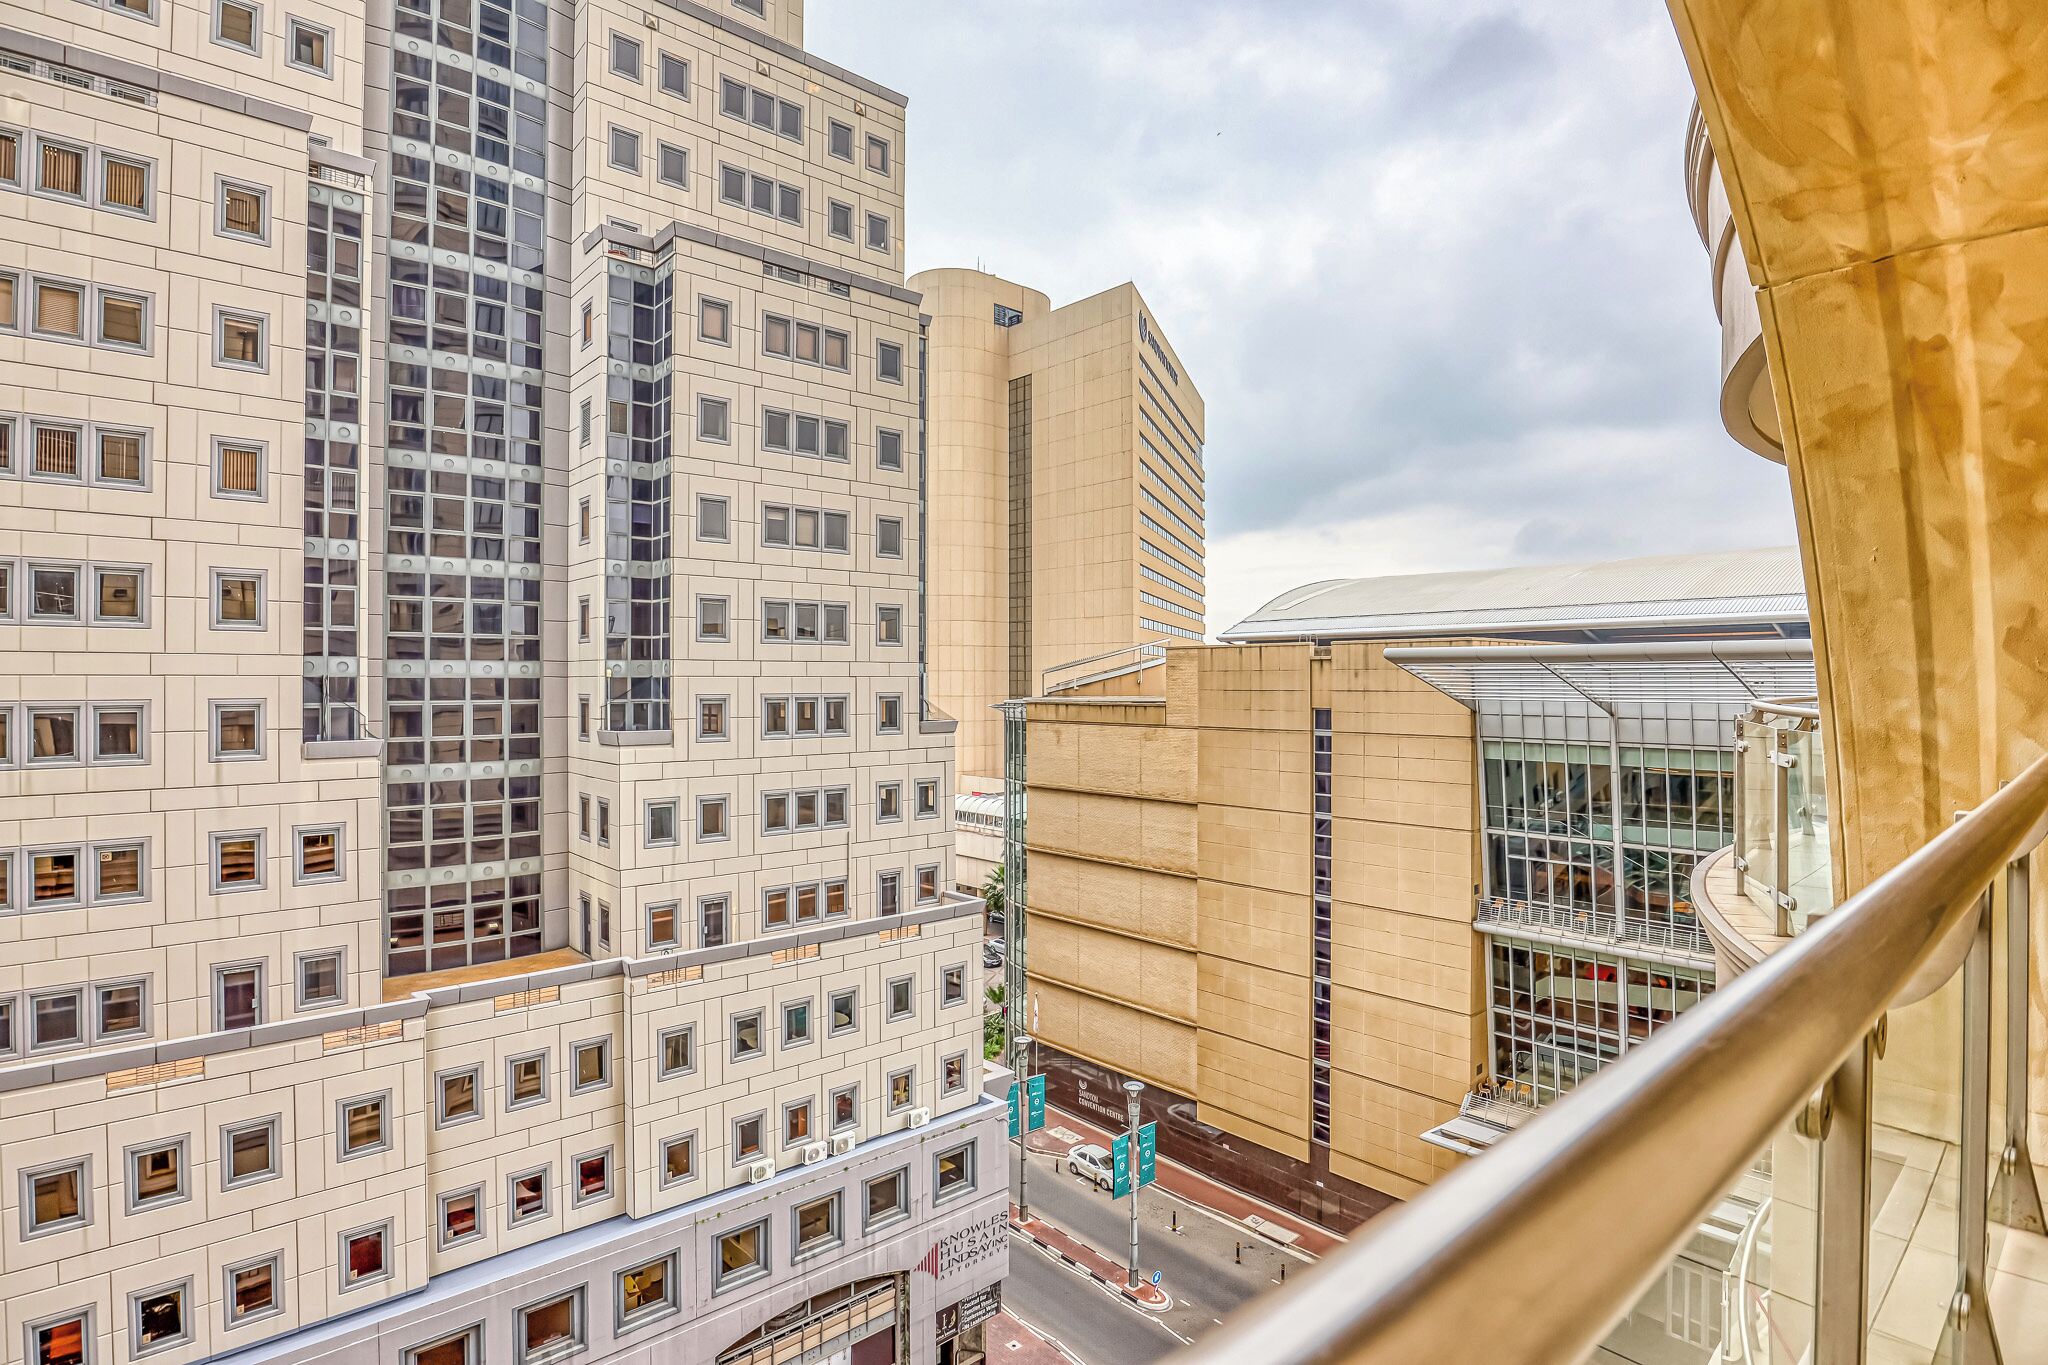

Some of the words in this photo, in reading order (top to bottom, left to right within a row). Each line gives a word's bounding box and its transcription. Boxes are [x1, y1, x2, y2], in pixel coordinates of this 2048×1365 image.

[1079, 1097, 1106, 1115] CONVENTION
[1107, 1109, 1124, 1122] CENTRE
[940, 1211, 1008, 1249] KNOWLES
[940, 1222, 1008, 1260] HUSAIN
[940, 1239, 992, 1272] LINDSAY
[992, 1234, 1008, 1248] INC
[940, 1244, 1008, 1280] ATTORNEYS
